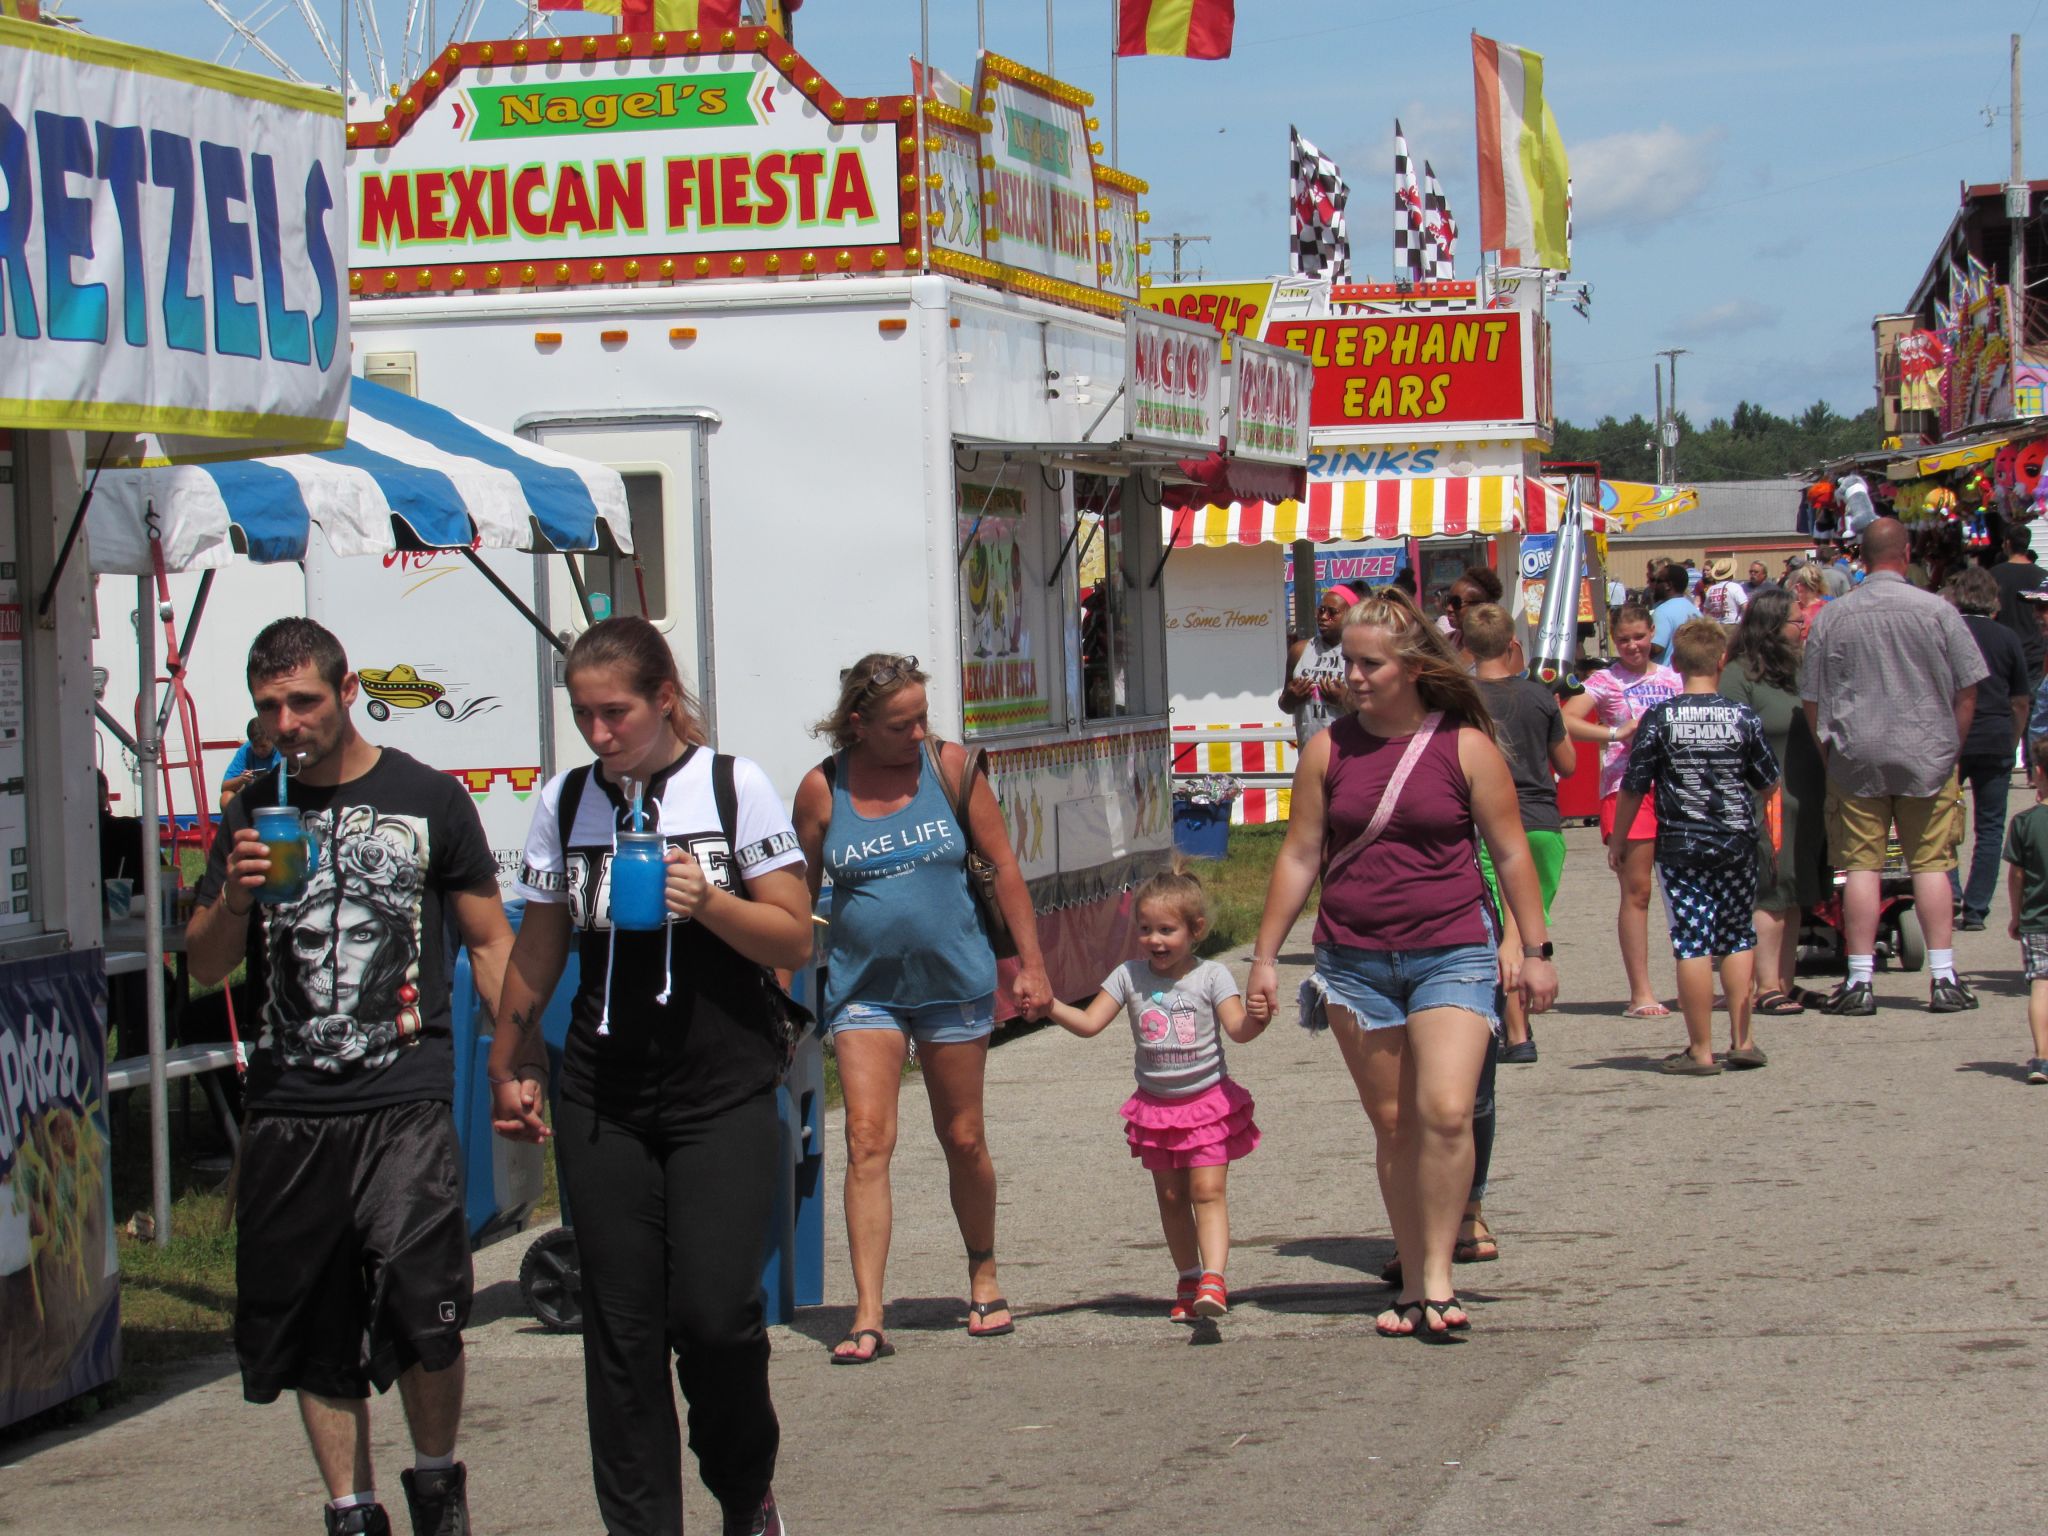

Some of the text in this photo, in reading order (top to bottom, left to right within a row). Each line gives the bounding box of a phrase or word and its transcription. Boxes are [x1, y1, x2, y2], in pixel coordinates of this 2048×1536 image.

[499, 83, 729, 128] Nagel's
[1012, 115, 1066, 167] Nagel's
[359, 148, 879, 252] MEXICAN FIESTA
[1050, 185, 1093, 262] FIESTA
[1136, 329, 1211, 401] NACHOS
[1284, 321, 1509, 369] ELEPHANT
[1342, 373, 1451, 419] EARS
[1329, 555, 1397, 580] WIZE
[1182, 610, 1222, 629] Some
[832, 819, 952, 869] LAKE LIFE
[922, 839, 955, 863] WAVES
